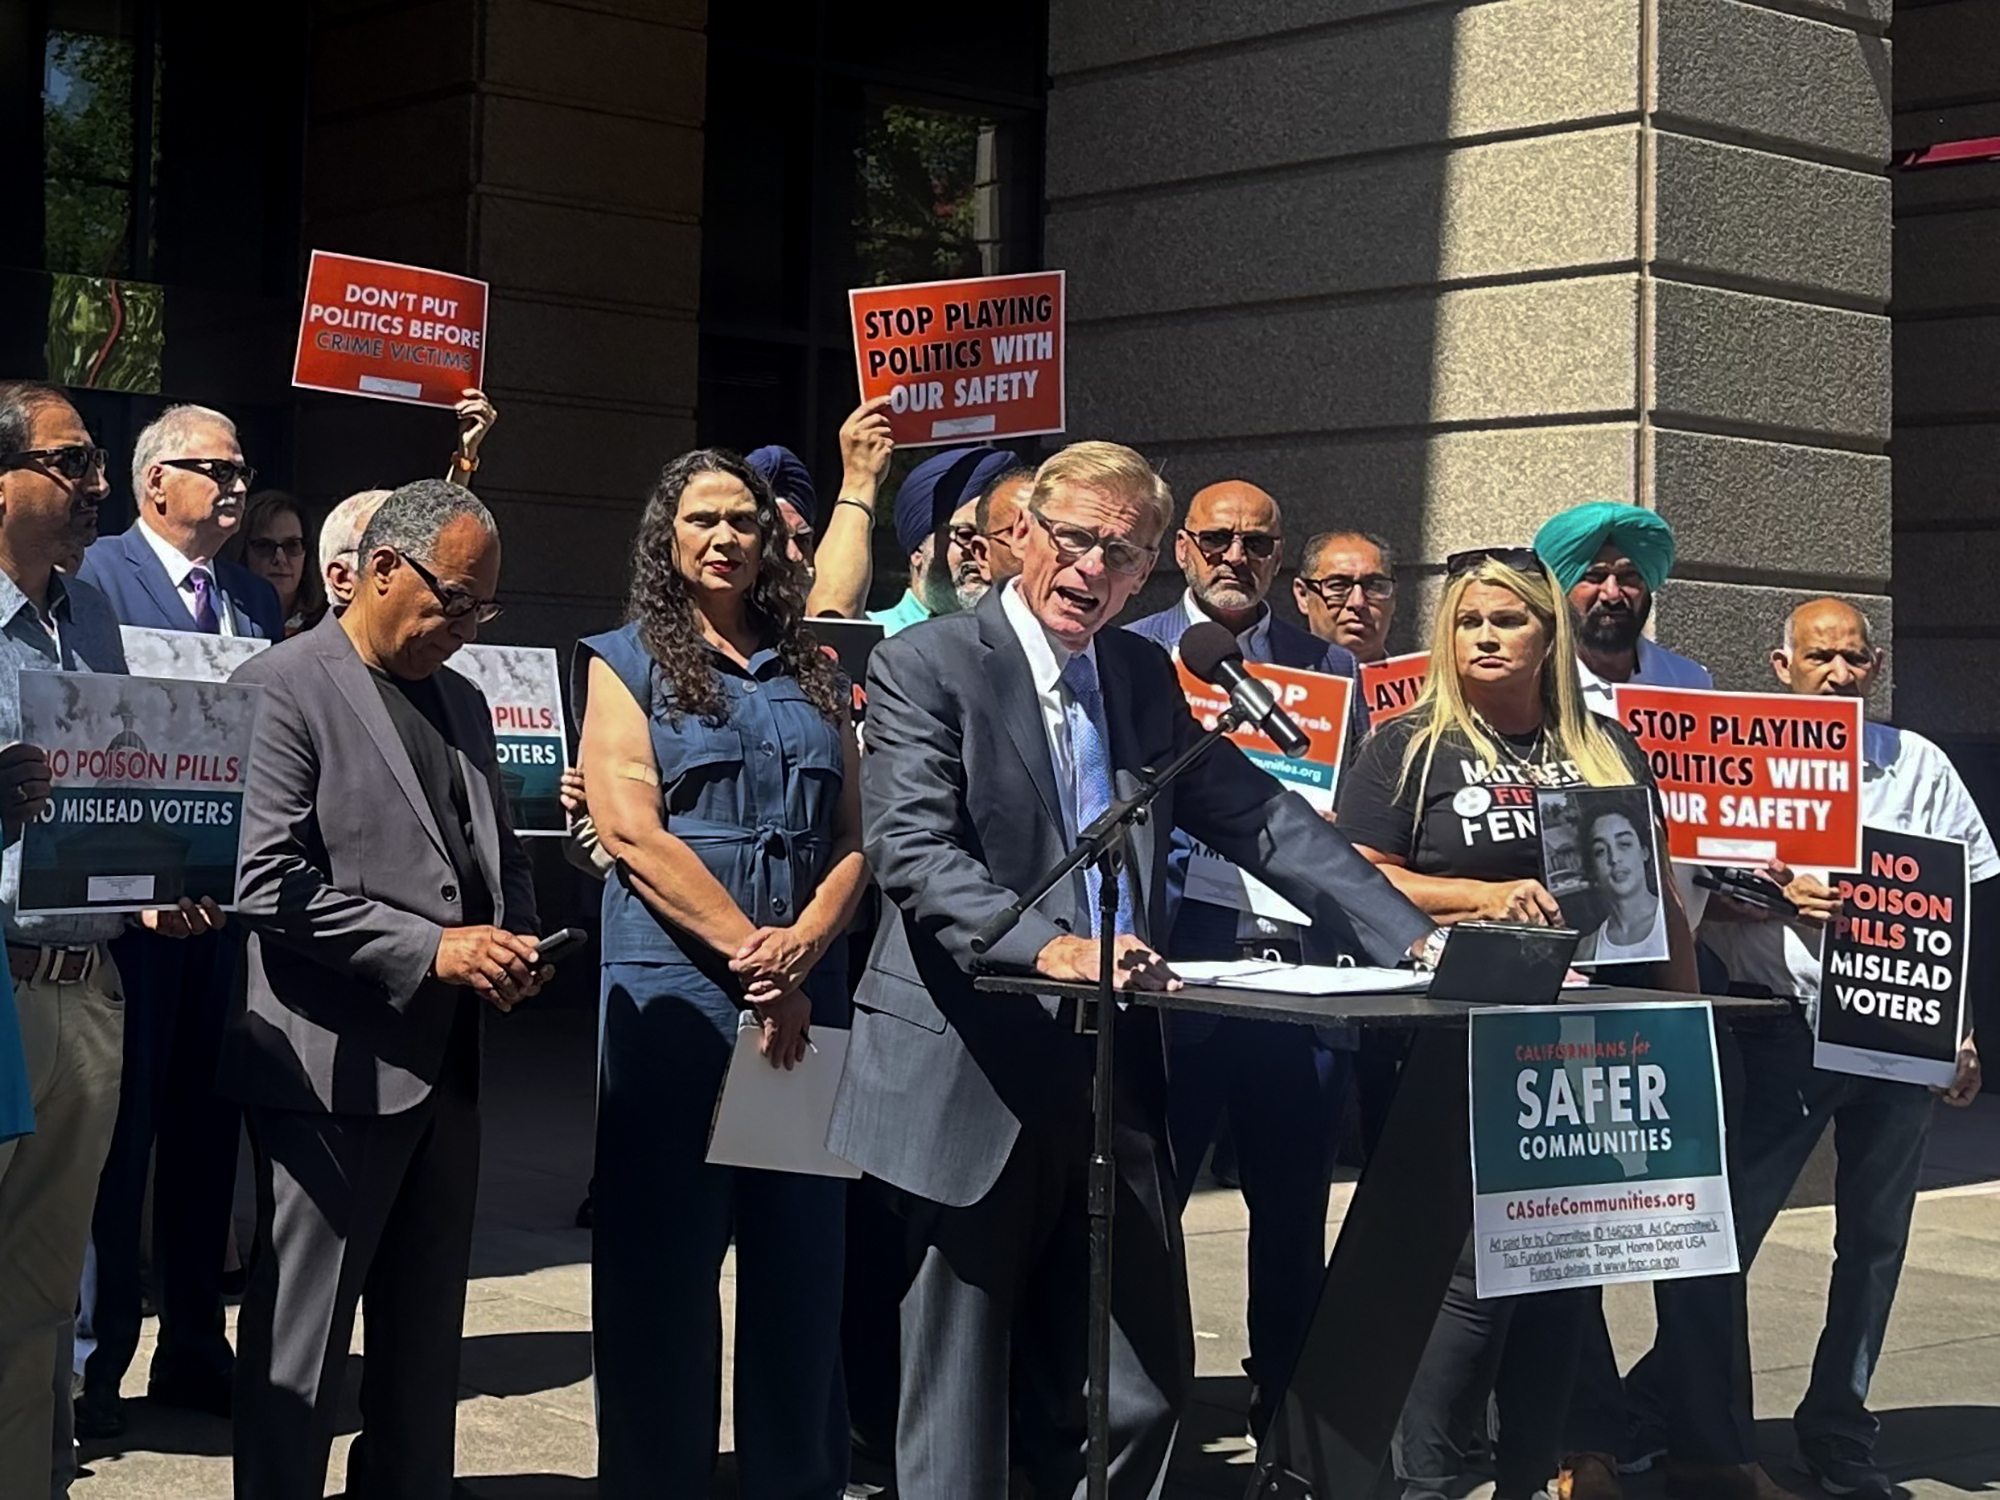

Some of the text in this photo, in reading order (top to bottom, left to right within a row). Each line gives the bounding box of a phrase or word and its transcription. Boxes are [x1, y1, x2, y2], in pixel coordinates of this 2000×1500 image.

[345, 283, 458, 319] DON'T PUT
[865, 294, 1053, 339] STOP PLAYING
[309, 304, 481, 349] POLITICS BEFORE
[316, 331, 473, 372] CRIME VICTIMS
[868, 331, 1053, 377] POLITICS WITH
[890, 369, 1039, 414] OUR SAFETY
[495, 706, 553, 730] PILLS
[1628, 708, 1848, 751] STOP PLAYING
[47, 749, 240, 783] O POISON PILLS
[496, 742, 556, 765] OTERS
[1641, 749, 1850, 792] OLITICS WITH
[33, 797, 233, 826] O MISLEAD VOTERS
[1719, 794, 1833, 831] SAFETY
[1871, 851, 1920, 883] NO
[1838, 880, 1953, 923] POISON
[1834, 916, 1952, 957] PILLS TO
[1830, 950, 1953, 992] MISLEAD
[1834, 984, 1942, 1026] VOTERS
[1515, 1031, 1651, 1065] CALIFORNIANS for
[1516, 1063, 1671, 1130] SAFER
[1519, 1127, 1673, 1161] COMMUNITIES
[1506, 1190, 1696, 1221] CASafeCommunities.org
[1521, 1233, 1532, 1247] for
[1626, 1240, 1654, 1254] Home
[1656, 1238, 1684, 1253] Depot
[1686, 1235, 1707, 1249] USA
